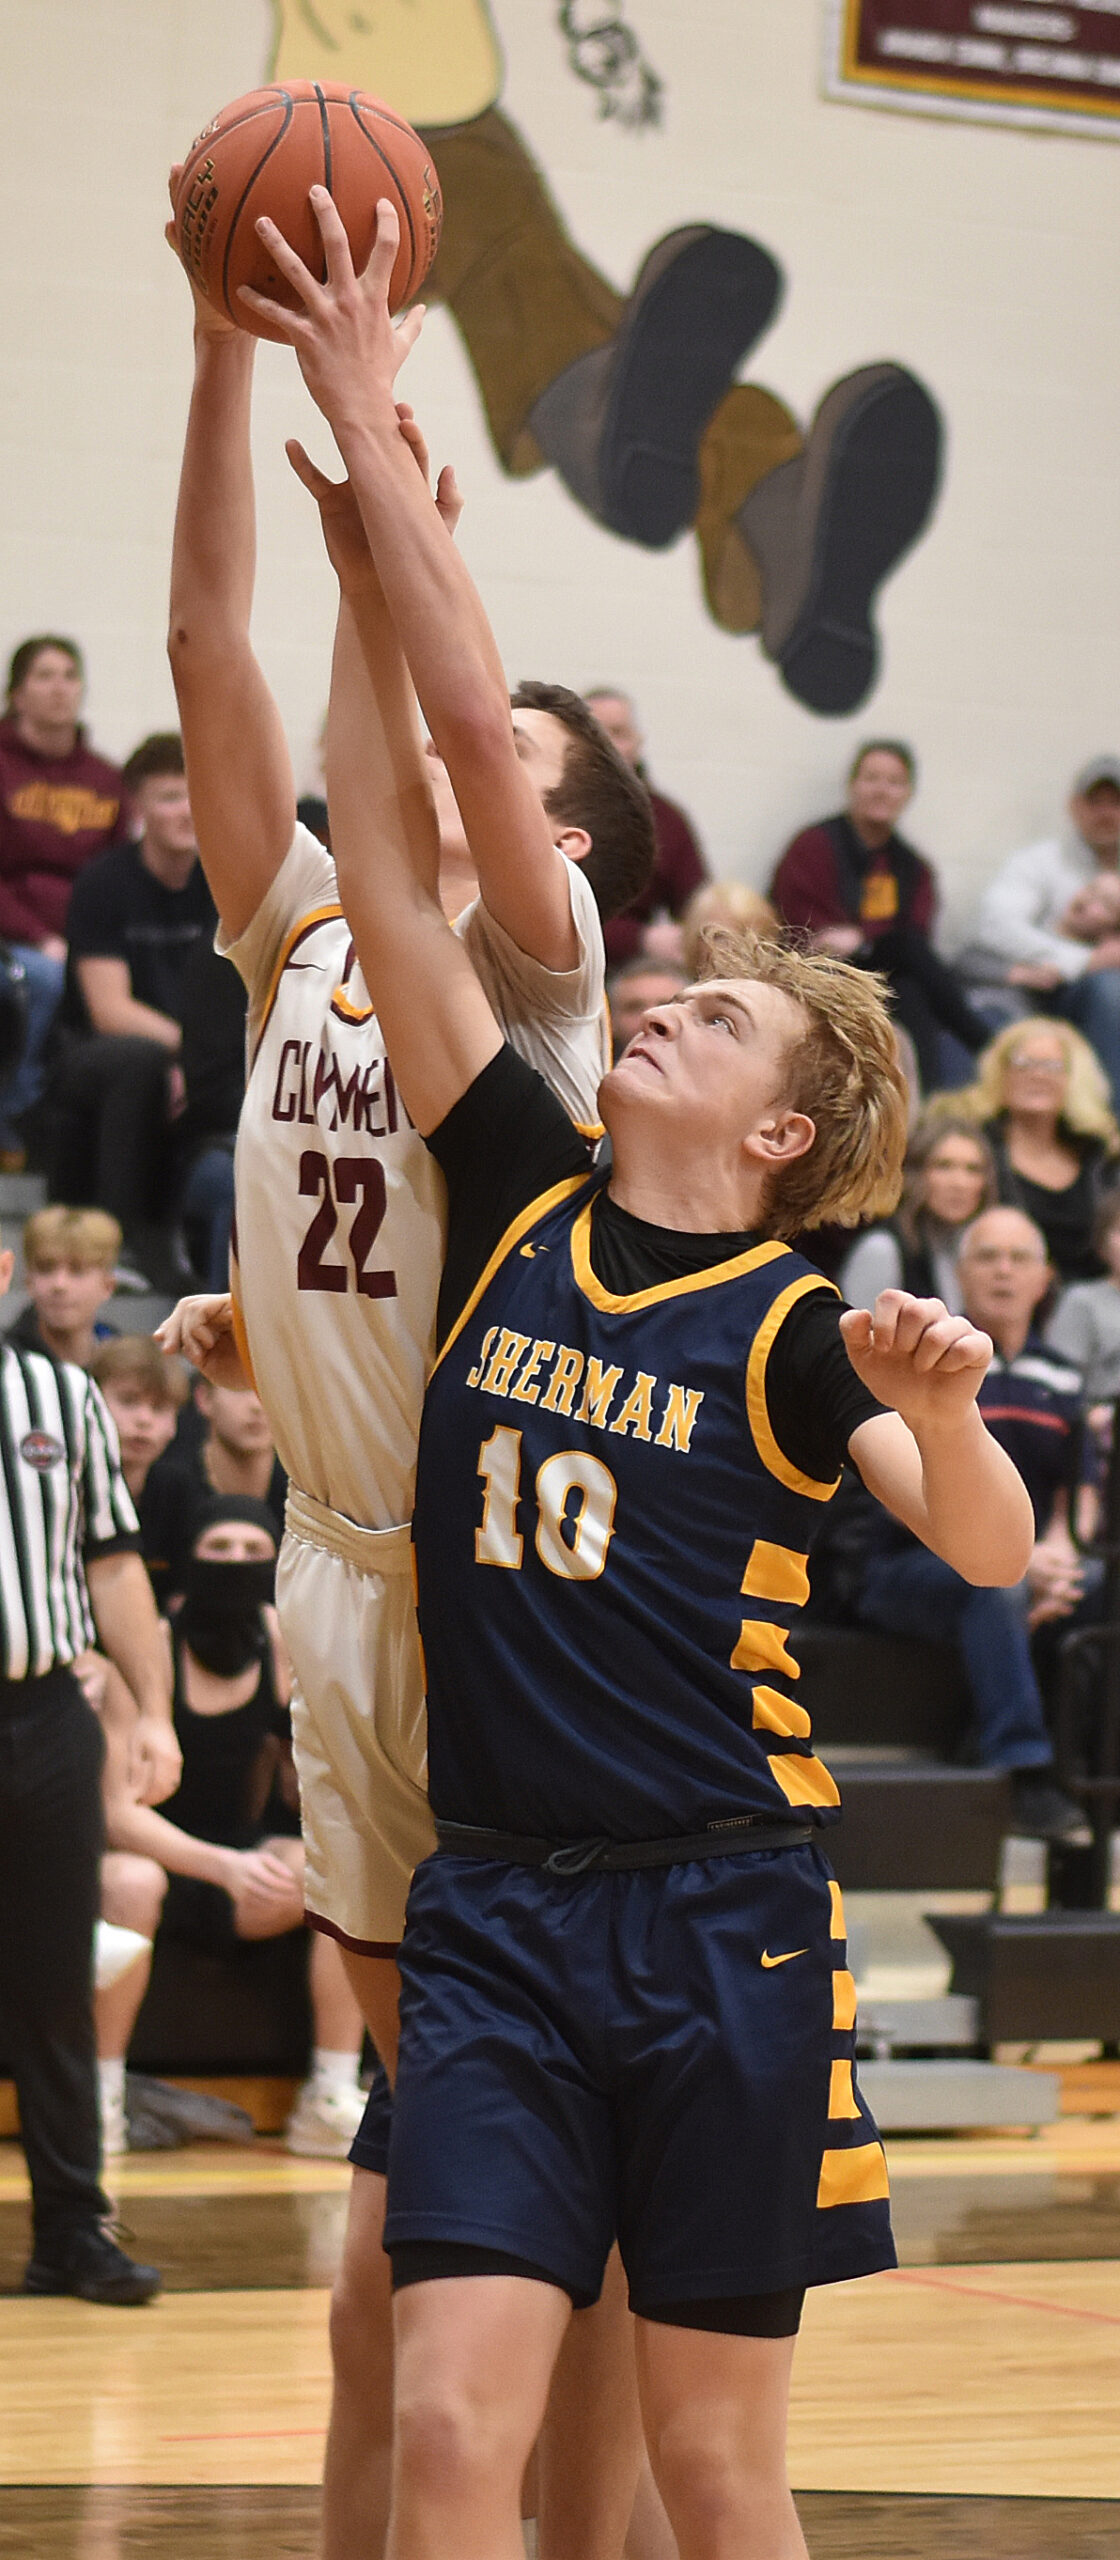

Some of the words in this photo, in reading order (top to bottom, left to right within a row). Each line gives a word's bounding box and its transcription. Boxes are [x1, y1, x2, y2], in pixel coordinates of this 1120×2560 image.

[298, 1150, 398, 1299] 22
[465, 1326, 705, 1454] SHERMAN
[474, 1424, 618, 1582] 10
